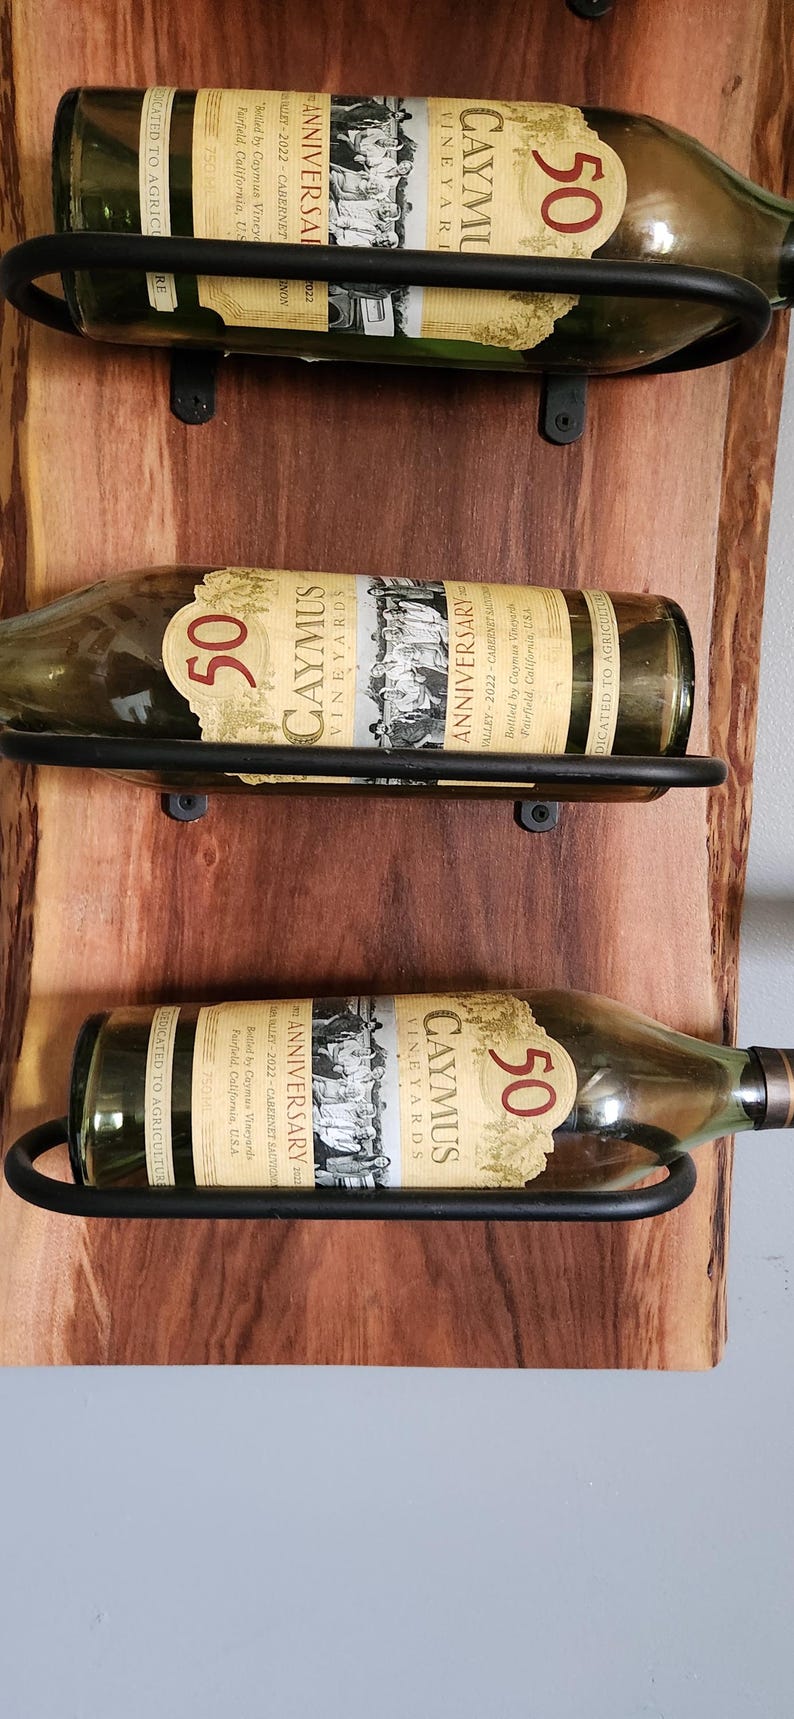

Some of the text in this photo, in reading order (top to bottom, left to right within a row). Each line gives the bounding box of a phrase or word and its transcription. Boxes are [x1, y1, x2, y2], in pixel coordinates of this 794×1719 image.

[233, 106, 247, 147] Fairfield,
[252, 136, 265, 148] by
[255, 105, 266, 134] Bottled
[278, 133, 289, 162] 2022
[148, 88, 167, 294] EDICATED TO AGRICURE
[204, 145, 217, 173] 750
[234, 151, 247, 216] California,
[251, 151, 263, 198] Caymus
[300, 103, 323, 246] ANNIVERSA
[459, 107, 505, 253] CAYMU
[532, 149, 606, 234] 50
[278, 174, 288, 240] CABERNET
[186, 614, 257, 689] 50
[281, 585, 326, 746] CAYMUS
[331, 590, 346, 736] VINEYARDS
[452, 597, 475, 744] ANNIVERSARY
[483, 616, 497, 664] CABERNET
[504, 603, 521, 740] Bottled by Caymus Vineyards
[522, 631, 537, 685] California,
[485, 674, 497, 703] 2022
[592, 592, 613, 756] DICATED TO AGRICULTURE
[481, 712, 494, 748] VALLEY
[520, 688, 535, 738] Fairfield,
[229, 1028, 241, 1068] Fairfield,
[266, 1053, 276, 1078] 2022
[152, 1011, 170, 1187] DEDICATED TO AGRICULTURE
[228, 1071, 241, 1125] California,
[243, 1026, 256, 1161] Bottled by Caymus Vineyards
[267, 1088, 277, 1140] CABERNET
[287, 1020, 307, 1164] ANNIVERSARY
[407, 1017, 424, 1160] VINEYARDS
[423, 1009, 463, 1165] CAYMUS
[488, 1048, 557, 1117] 50
[293, 1167, 302, 1185] 2022
